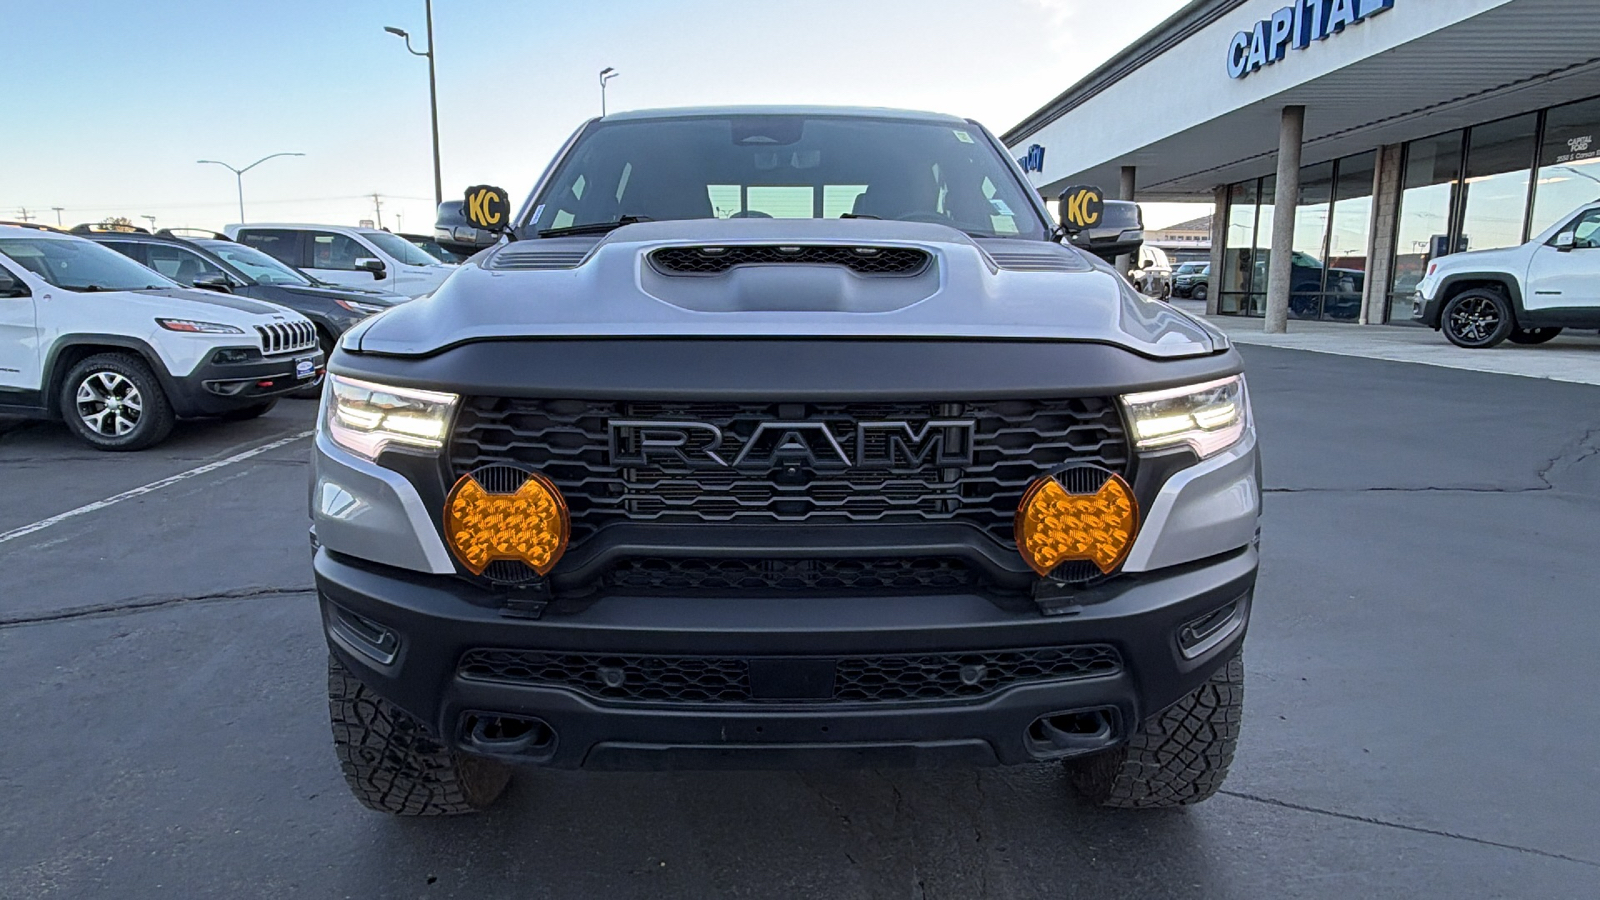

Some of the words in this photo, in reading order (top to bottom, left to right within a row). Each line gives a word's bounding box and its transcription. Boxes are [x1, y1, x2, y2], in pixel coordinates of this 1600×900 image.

[1567, 135, 1592, 146] CAPITAL
[1570, 142, 1588, 152] FORD
[469, 189, 500, 226] KC
[1068, 189, 1098, 226] KC
[607, 419, 977, 467] RAM
